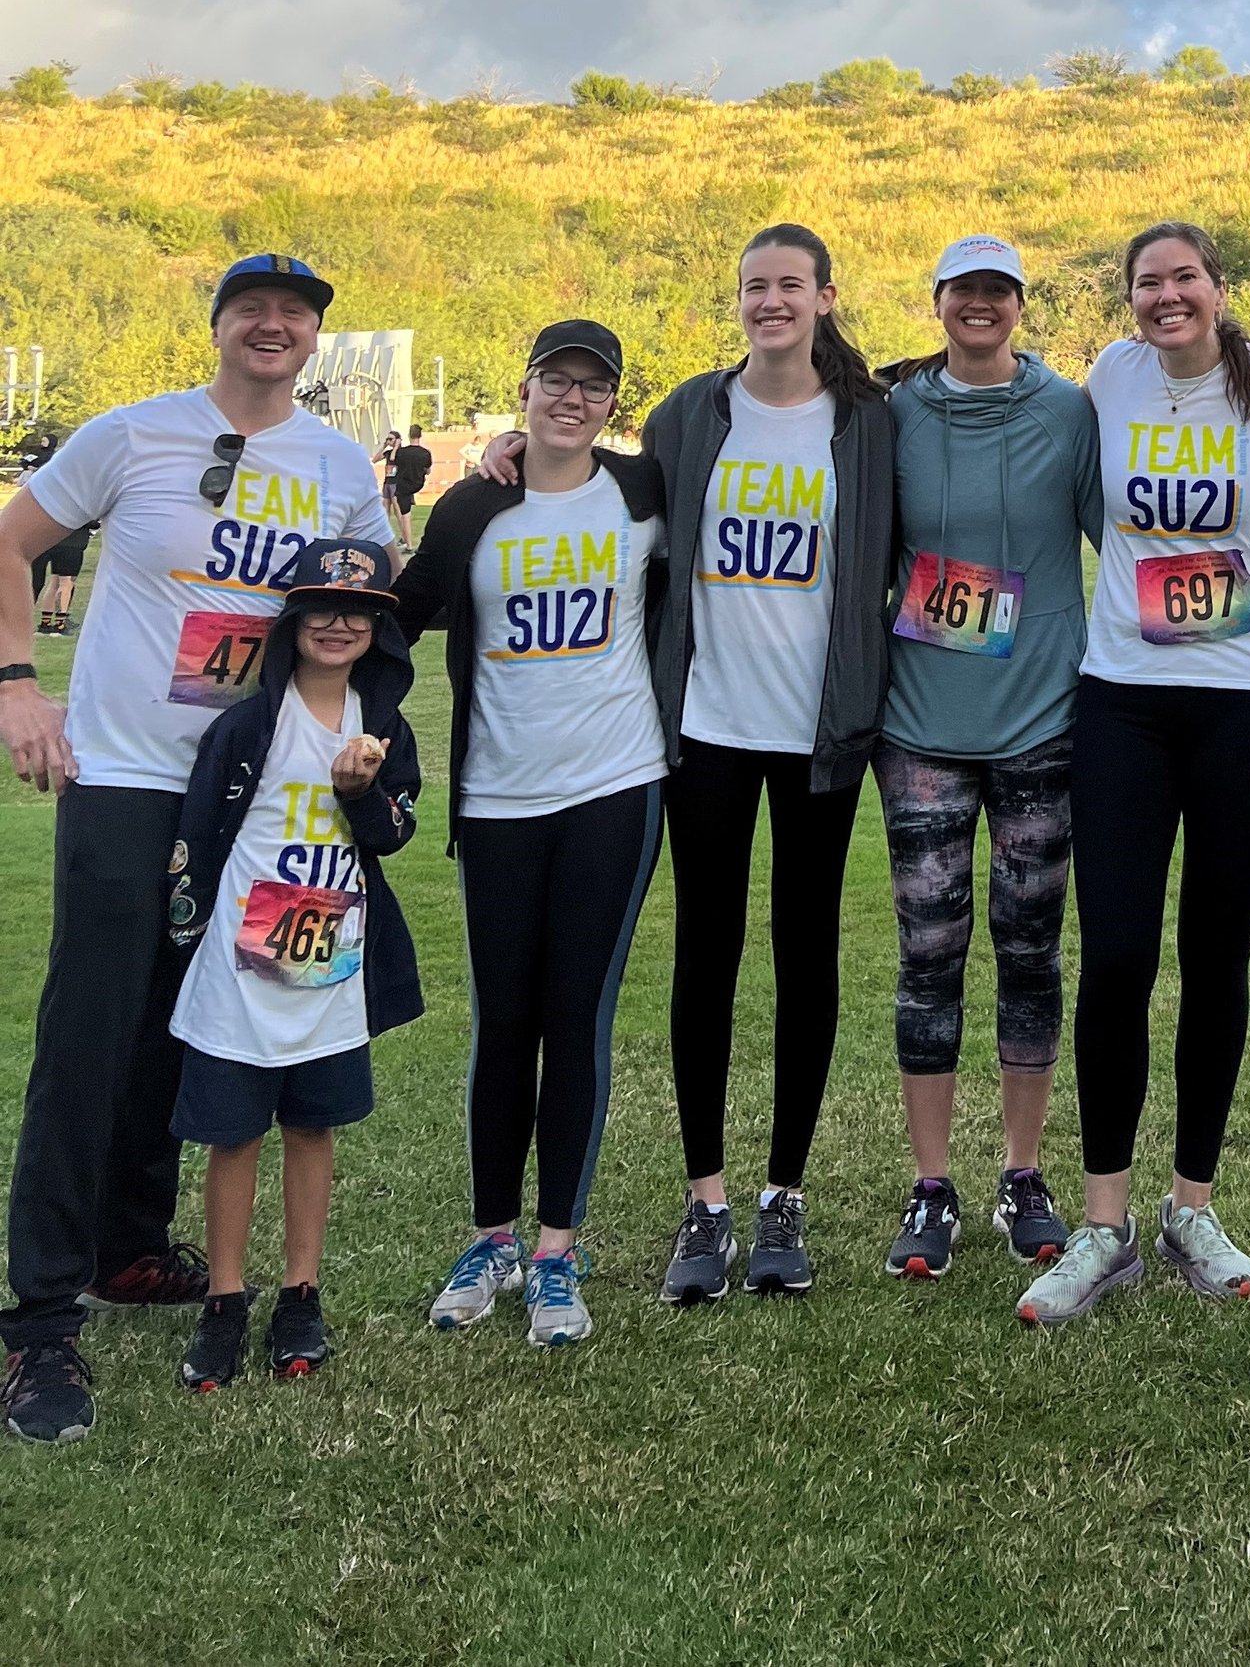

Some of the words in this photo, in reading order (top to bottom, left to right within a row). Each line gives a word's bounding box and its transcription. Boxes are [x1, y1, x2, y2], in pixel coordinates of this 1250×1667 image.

[1127, 422, 1236, 474] TEAM
[1238, 438, 1250, 476] Running
[214, 471, 320, 531] EAM
[717, 460, 826, 521] TEAM
[1127, 476, 1236, 533] SU2J
[206, 520, 307, 591] SU2
[495, 531, 617, 592] TEAM
[618, 544, 631, 584] Running
[620, 528, 630, 544] for
[718, 517, 820, 583] SU2J
[506, 587, 615, 654] SU2J
[923, 577, 994, 634] 461
[1163, 569, 1236, 624] 697
[202, 635, 263, 686] 47
[282, 781, 355, 845] TE
[276, 844, 359, 894] SU2
[264, 906, 345, 963] 465
